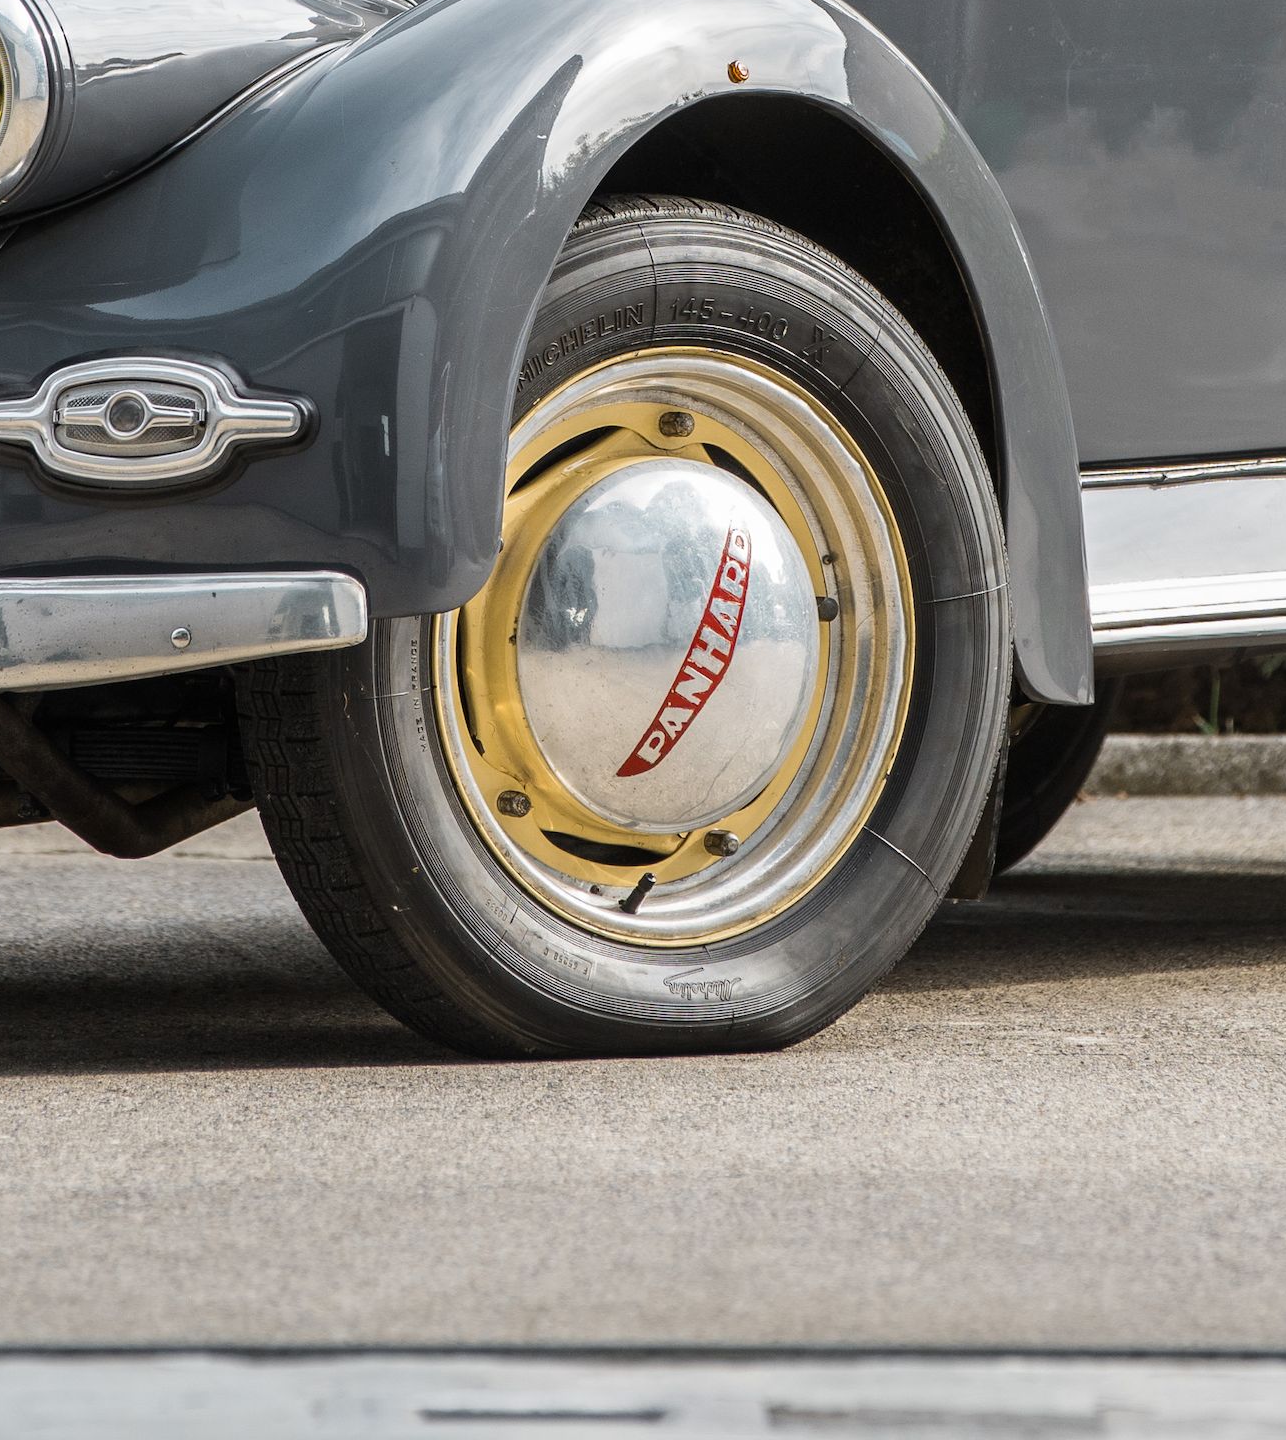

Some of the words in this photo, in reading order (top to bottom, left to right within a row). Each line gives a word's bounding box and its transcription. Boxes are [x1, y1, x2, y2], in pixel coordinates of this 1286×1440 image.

[516, 302, 644, 392] MICHELIN
[802, 323, 839, 364] X
[636, 529, 750, 764] PANHARD
[664, 973, 742, 1001] Michelin
